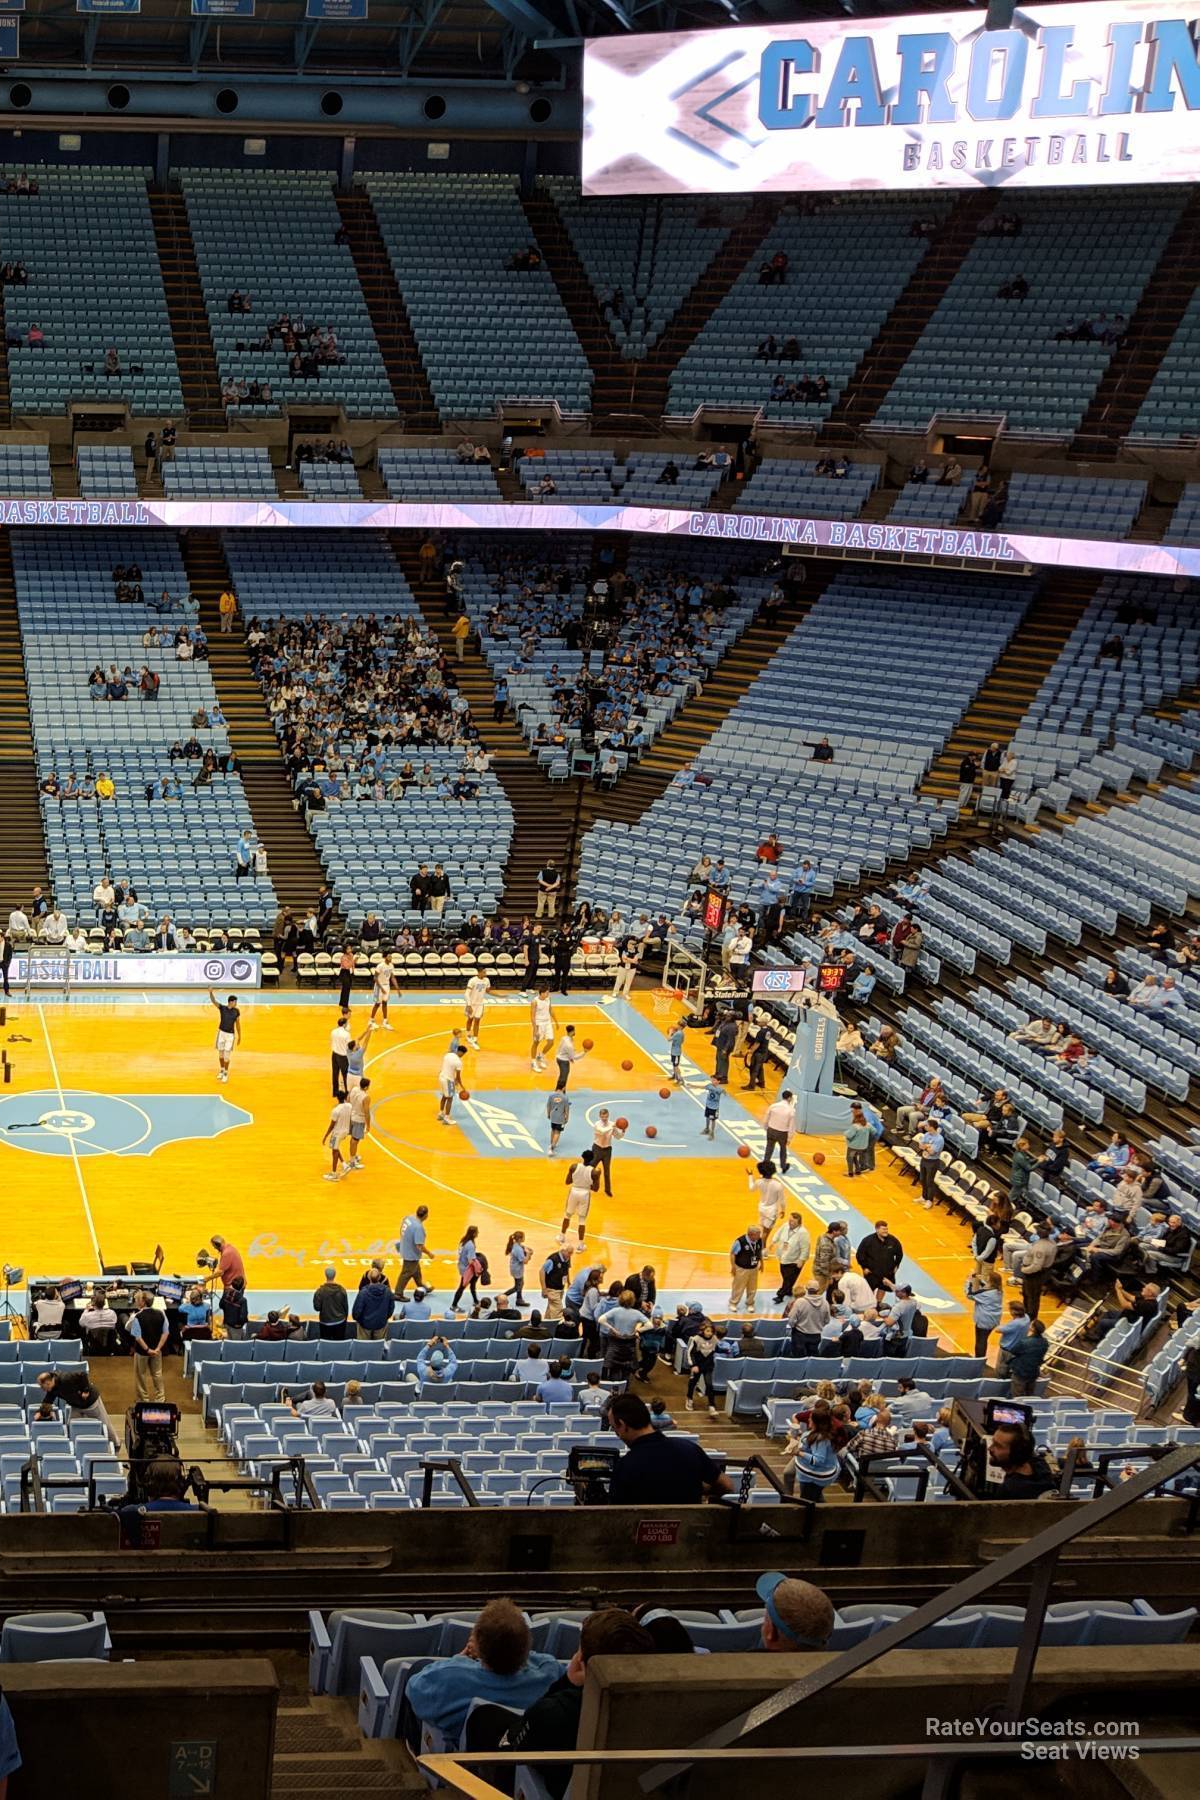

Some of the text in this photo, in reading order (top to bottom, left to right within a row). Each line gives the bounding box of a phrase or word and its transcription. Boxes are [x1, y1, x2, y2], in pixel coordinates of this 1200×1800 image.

[903, 132, 1133, 171] BASKETBALL
[689, 512, 1015, 560] CAROLINA BASKETBALL
[821, 968, 844, 976] 43:37
